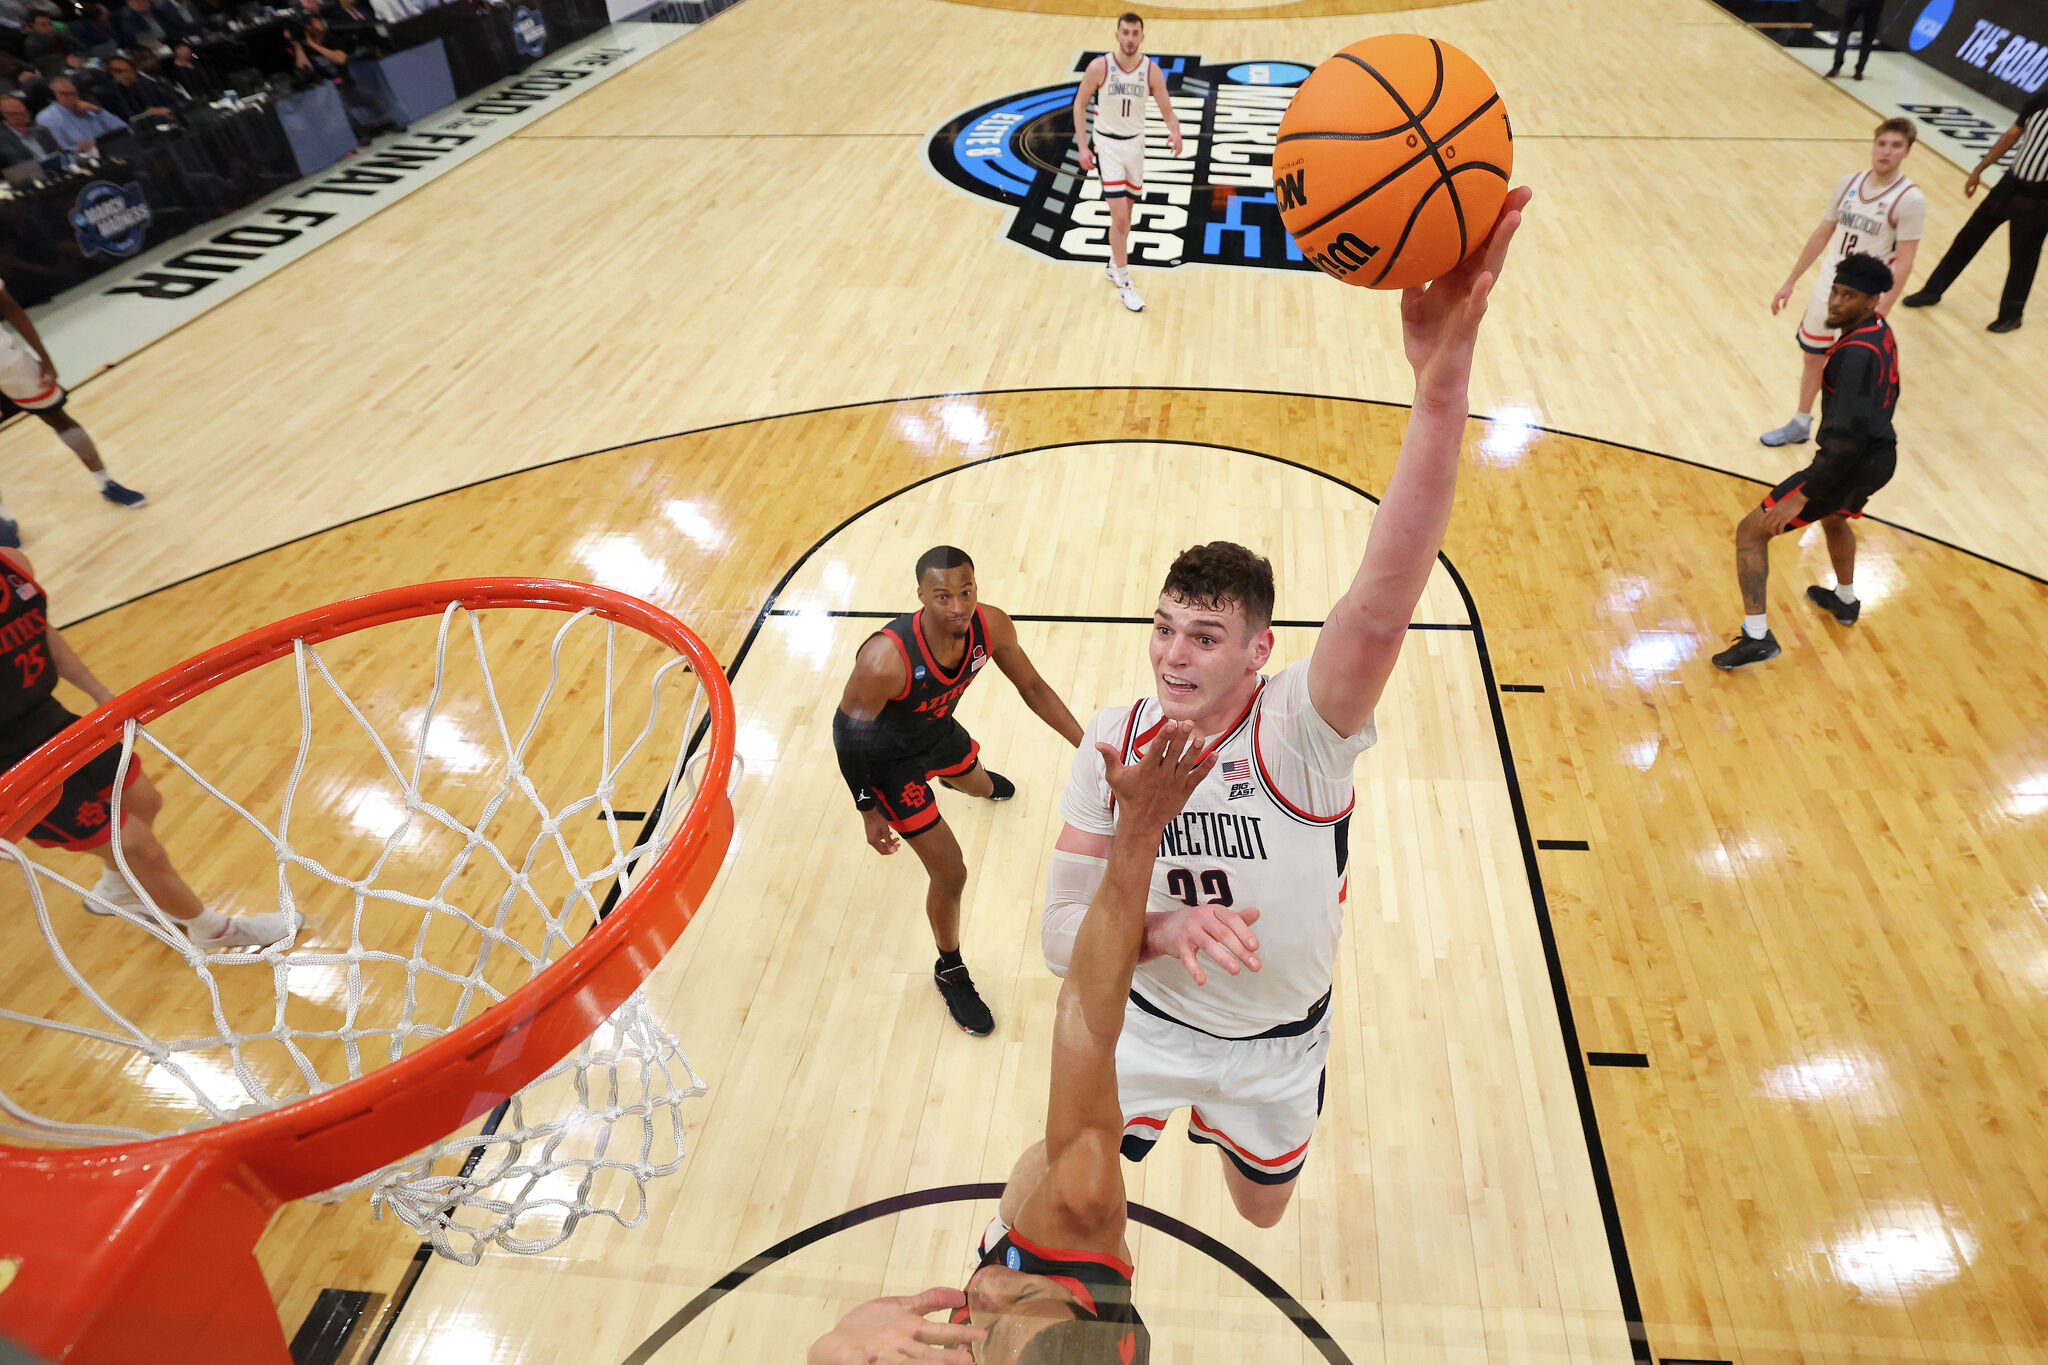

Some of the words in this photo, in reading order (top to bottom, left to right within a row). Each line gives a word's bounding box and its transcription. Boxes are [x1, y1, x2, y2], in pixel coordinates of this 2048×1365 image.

[1955, 18, 2011, 69] THE
[463, 69, 595, 115] ROAD
[1121, 98, 1131, 117] 11
[964, 113, 1025, 146] ELITE
[964, 146, 1003, 158] 8
[1208, 83, 1300, 188] MARCH
[295, 131, 477, 198] FINAL
[104, 208, 339, 300] FOUR
[1841, 231, 1859, 256] 12
[14, 643, 46, 688] 25
[1229, 787, 1256, 798] EAST
[1230, 782, 1249, 791] BIG
[1156, 811, 1267, 860] NECTICUT
